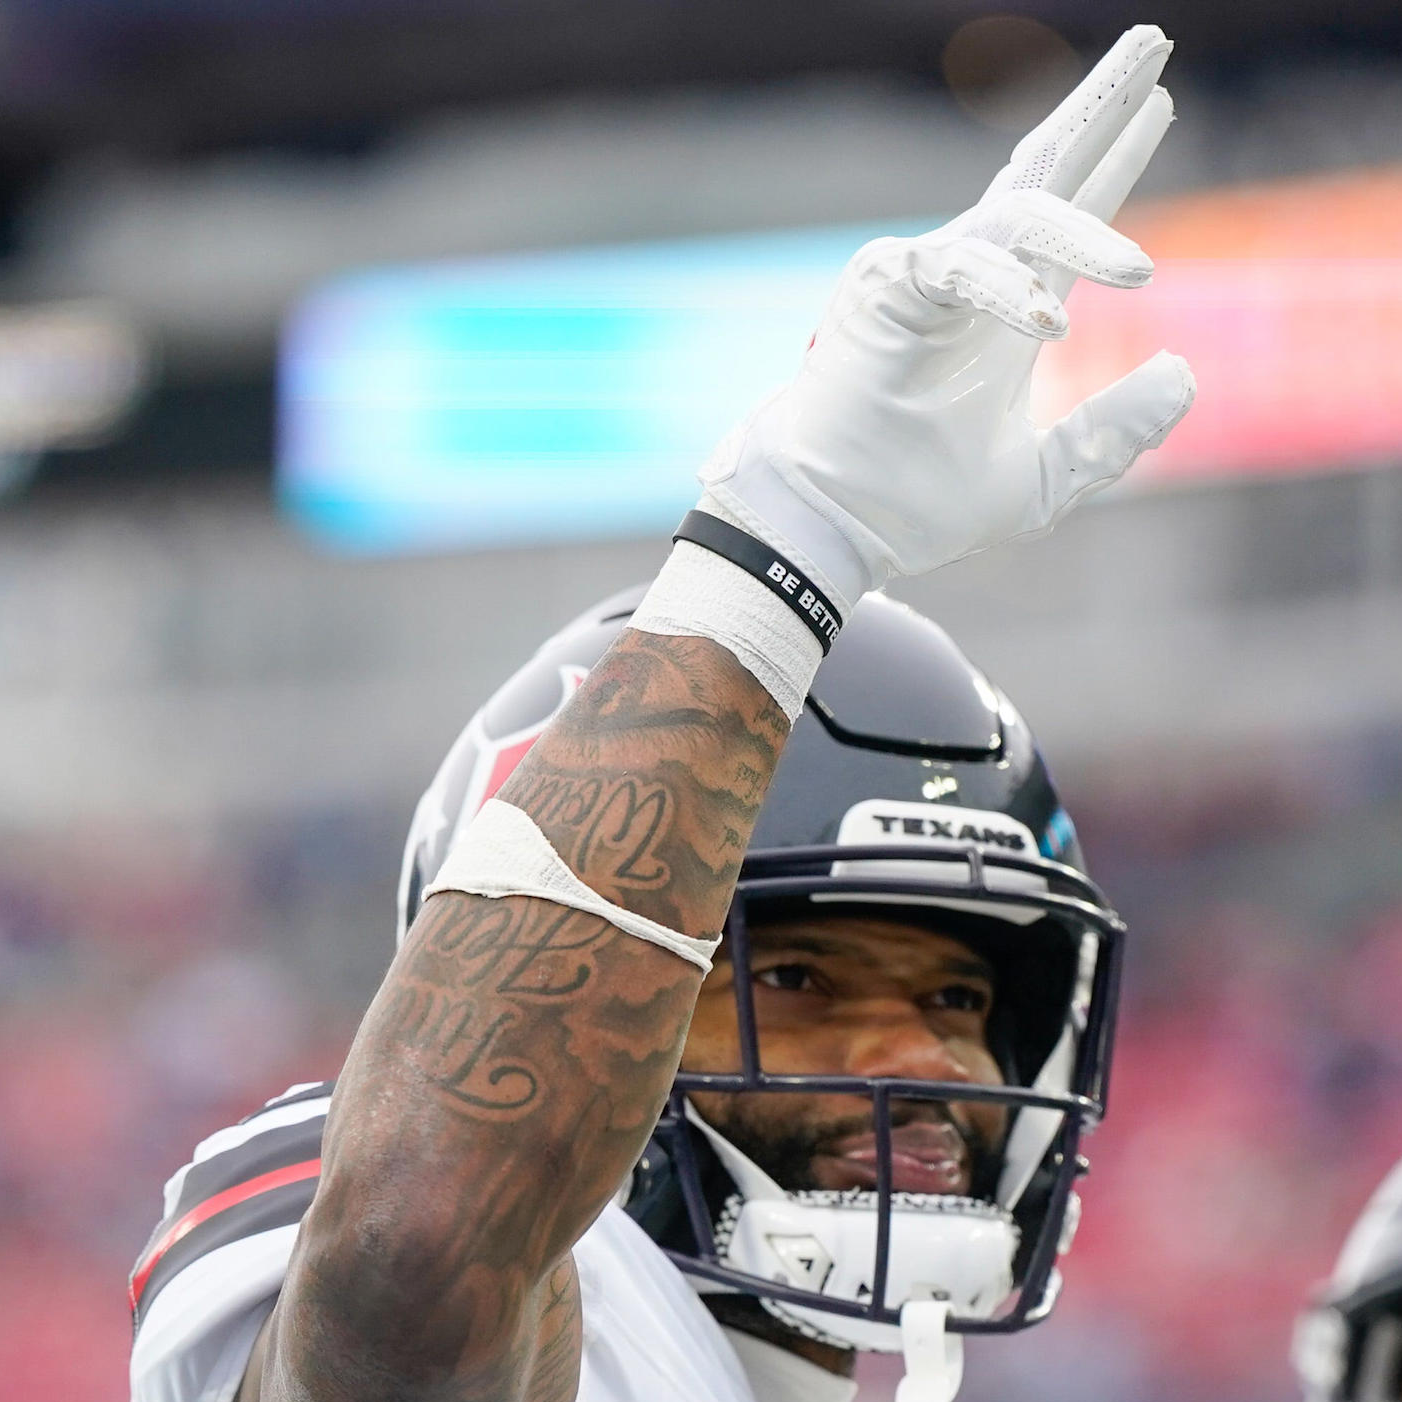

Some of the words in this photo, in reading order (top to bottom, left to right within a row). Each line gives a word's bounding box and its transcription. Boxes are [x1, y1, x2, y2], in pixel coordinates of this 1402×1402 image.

[766, 560, 801, 595] BE
[798, 588, 842, 645] BETTE
[872, 815, 1026, 850] TEXANS
